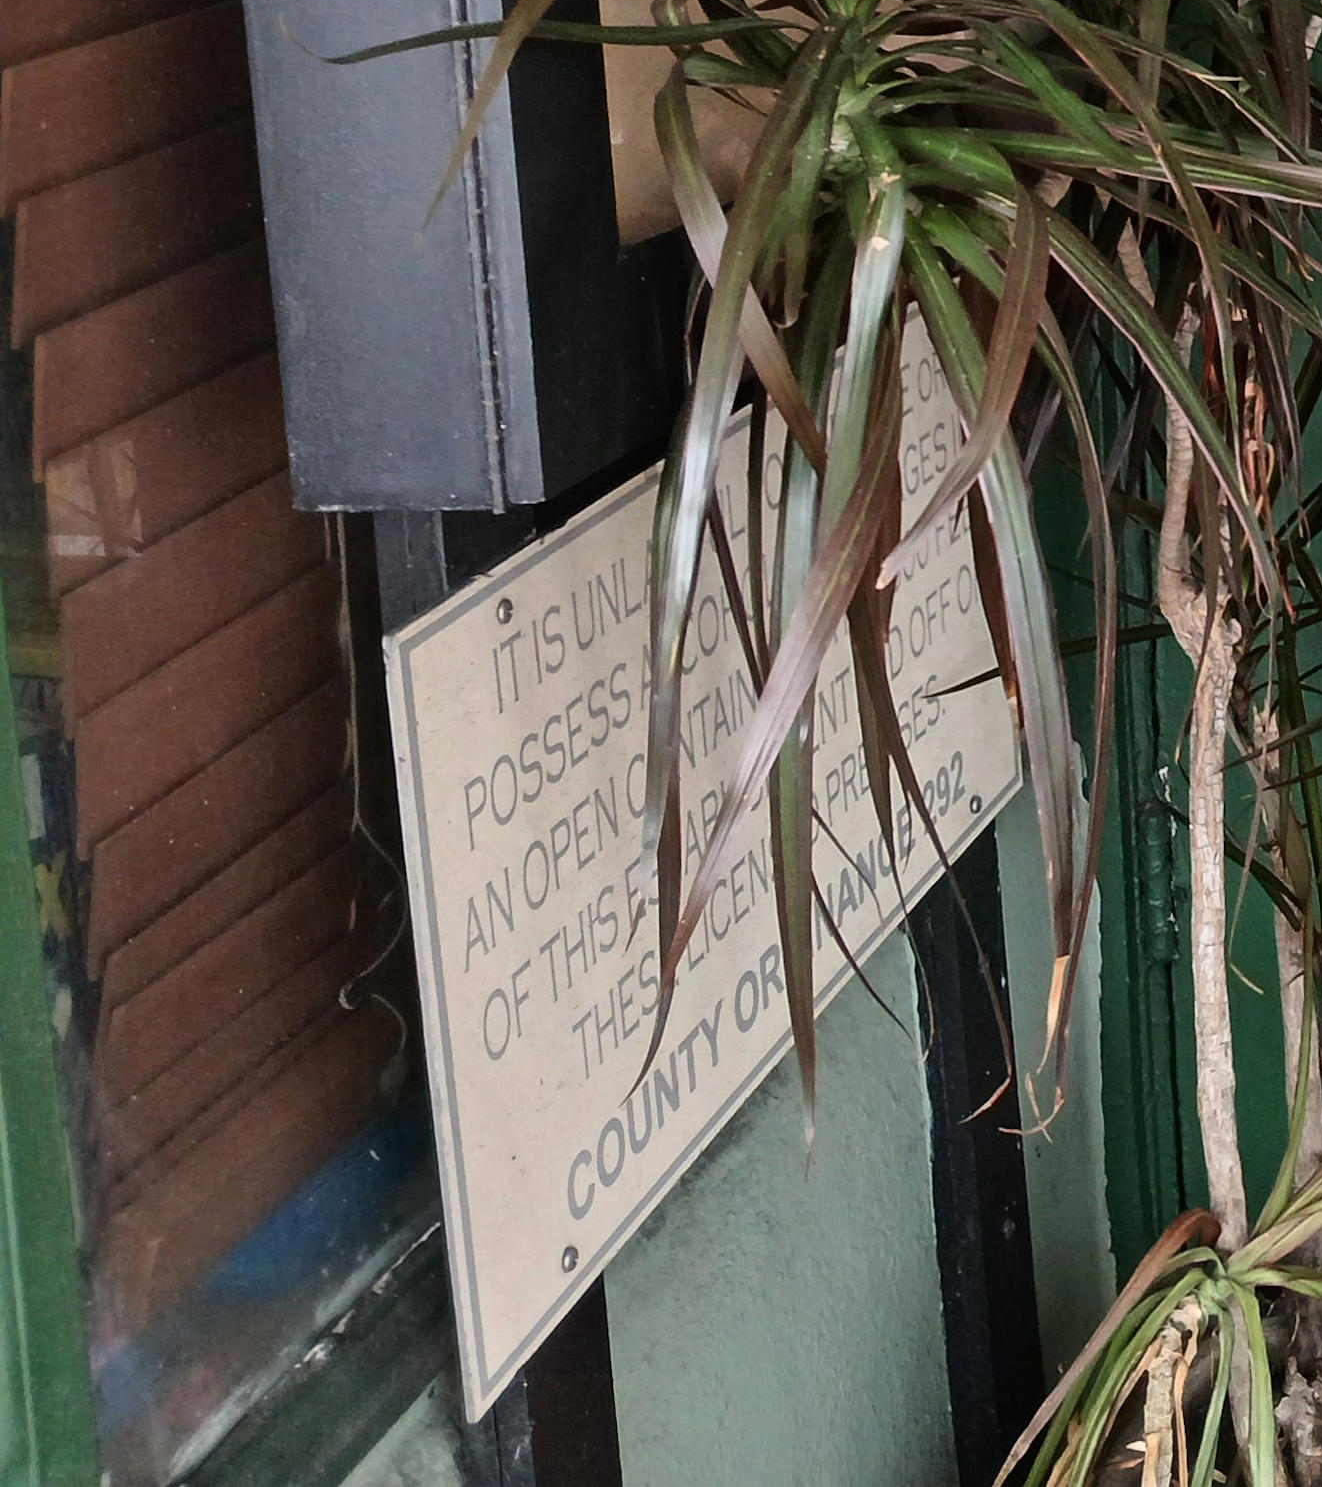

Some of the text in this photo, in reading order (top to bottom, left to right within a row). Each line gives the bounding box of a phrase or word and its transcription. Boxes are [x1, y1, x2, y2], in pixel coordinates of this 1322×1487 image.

[463, 662, 632, 852] POSSESS
[492, 630, 523, 715] IT
[531, 605, 565, 685] IS
[463, 868, 516, 973] AN
[522, 776, 619, 911] OPEN
[482, 960, 532, 1062] OF
[539, 884, 615, 1004] THIS
[909, 589, 950, 658] OFF
[567, 997, 725, 1222] COUNTY
